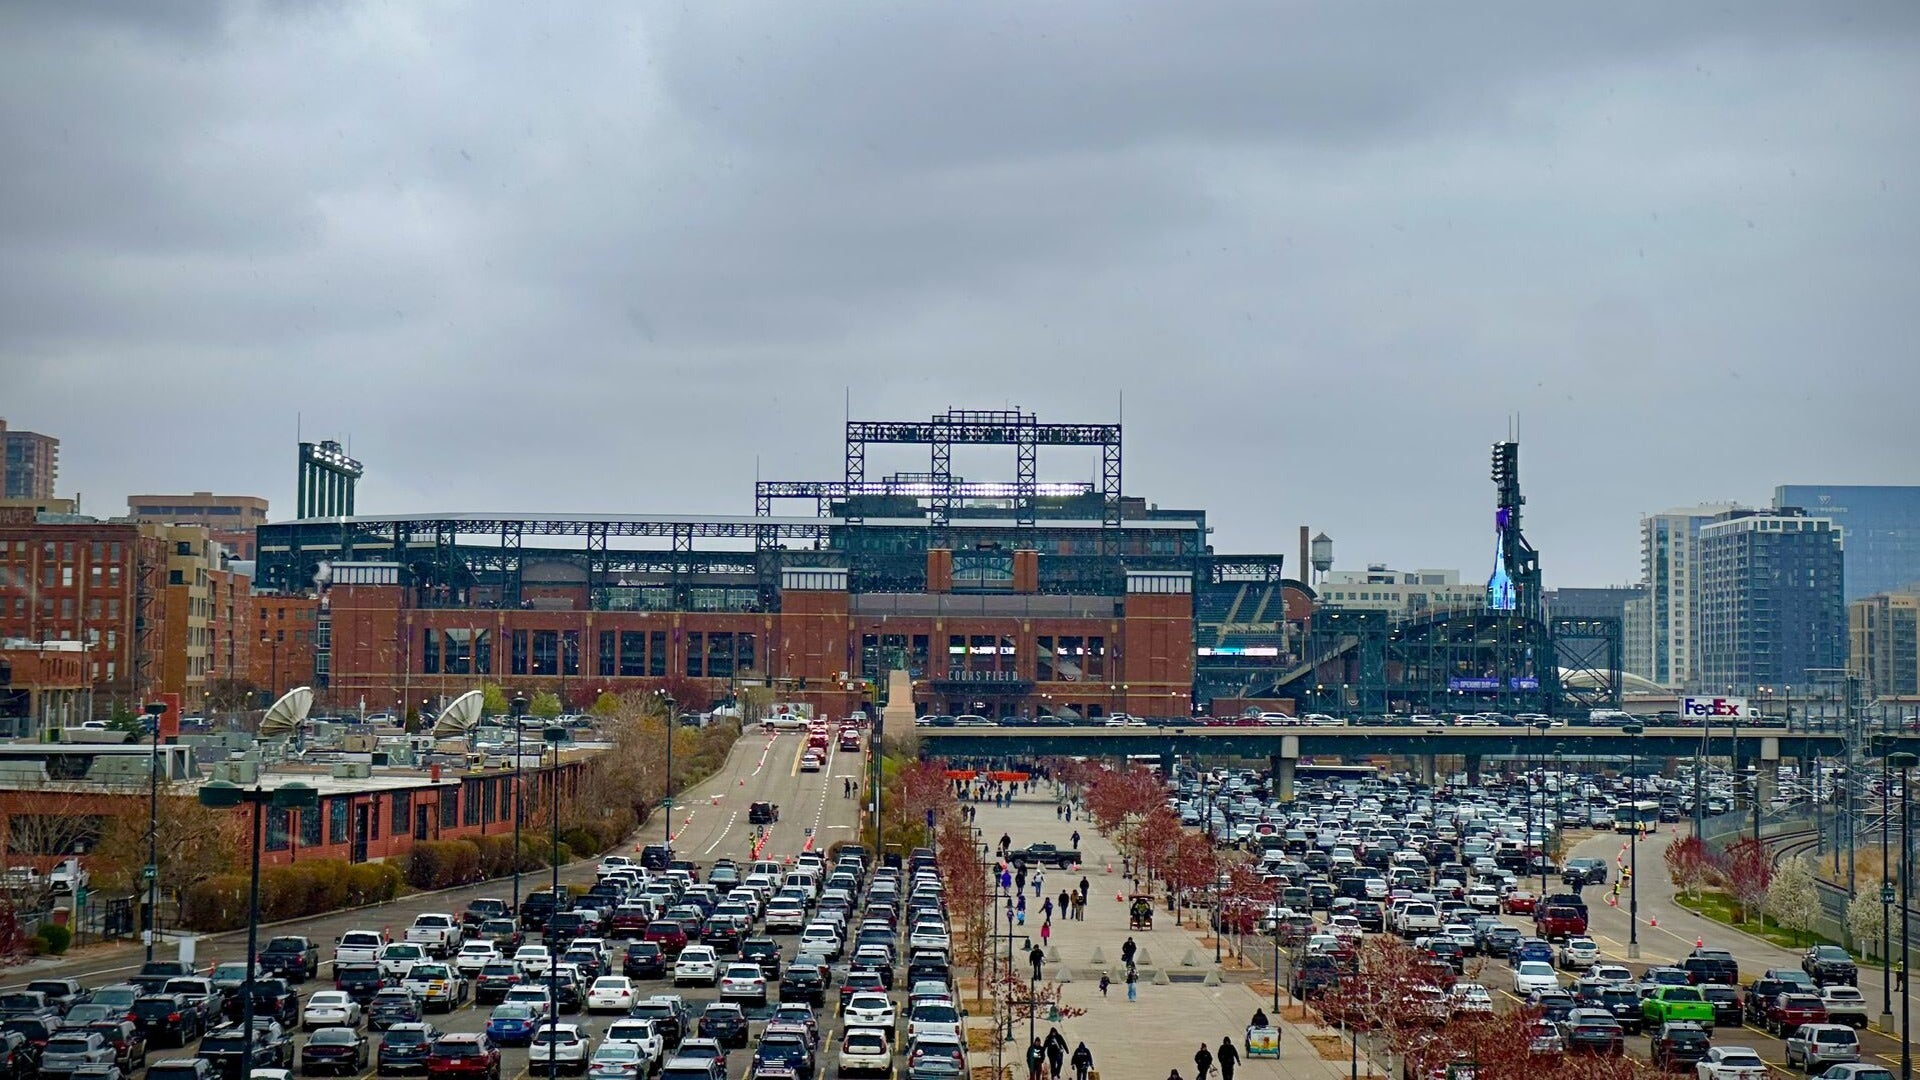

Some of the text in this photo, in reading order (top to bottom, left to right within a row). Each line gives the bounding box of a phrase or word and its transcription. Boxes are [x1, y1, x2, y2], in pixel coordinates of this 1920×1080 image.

[948, 670, 1018, 681] COORS FIELD
[1685, 698, 1740, 716] FedEx
